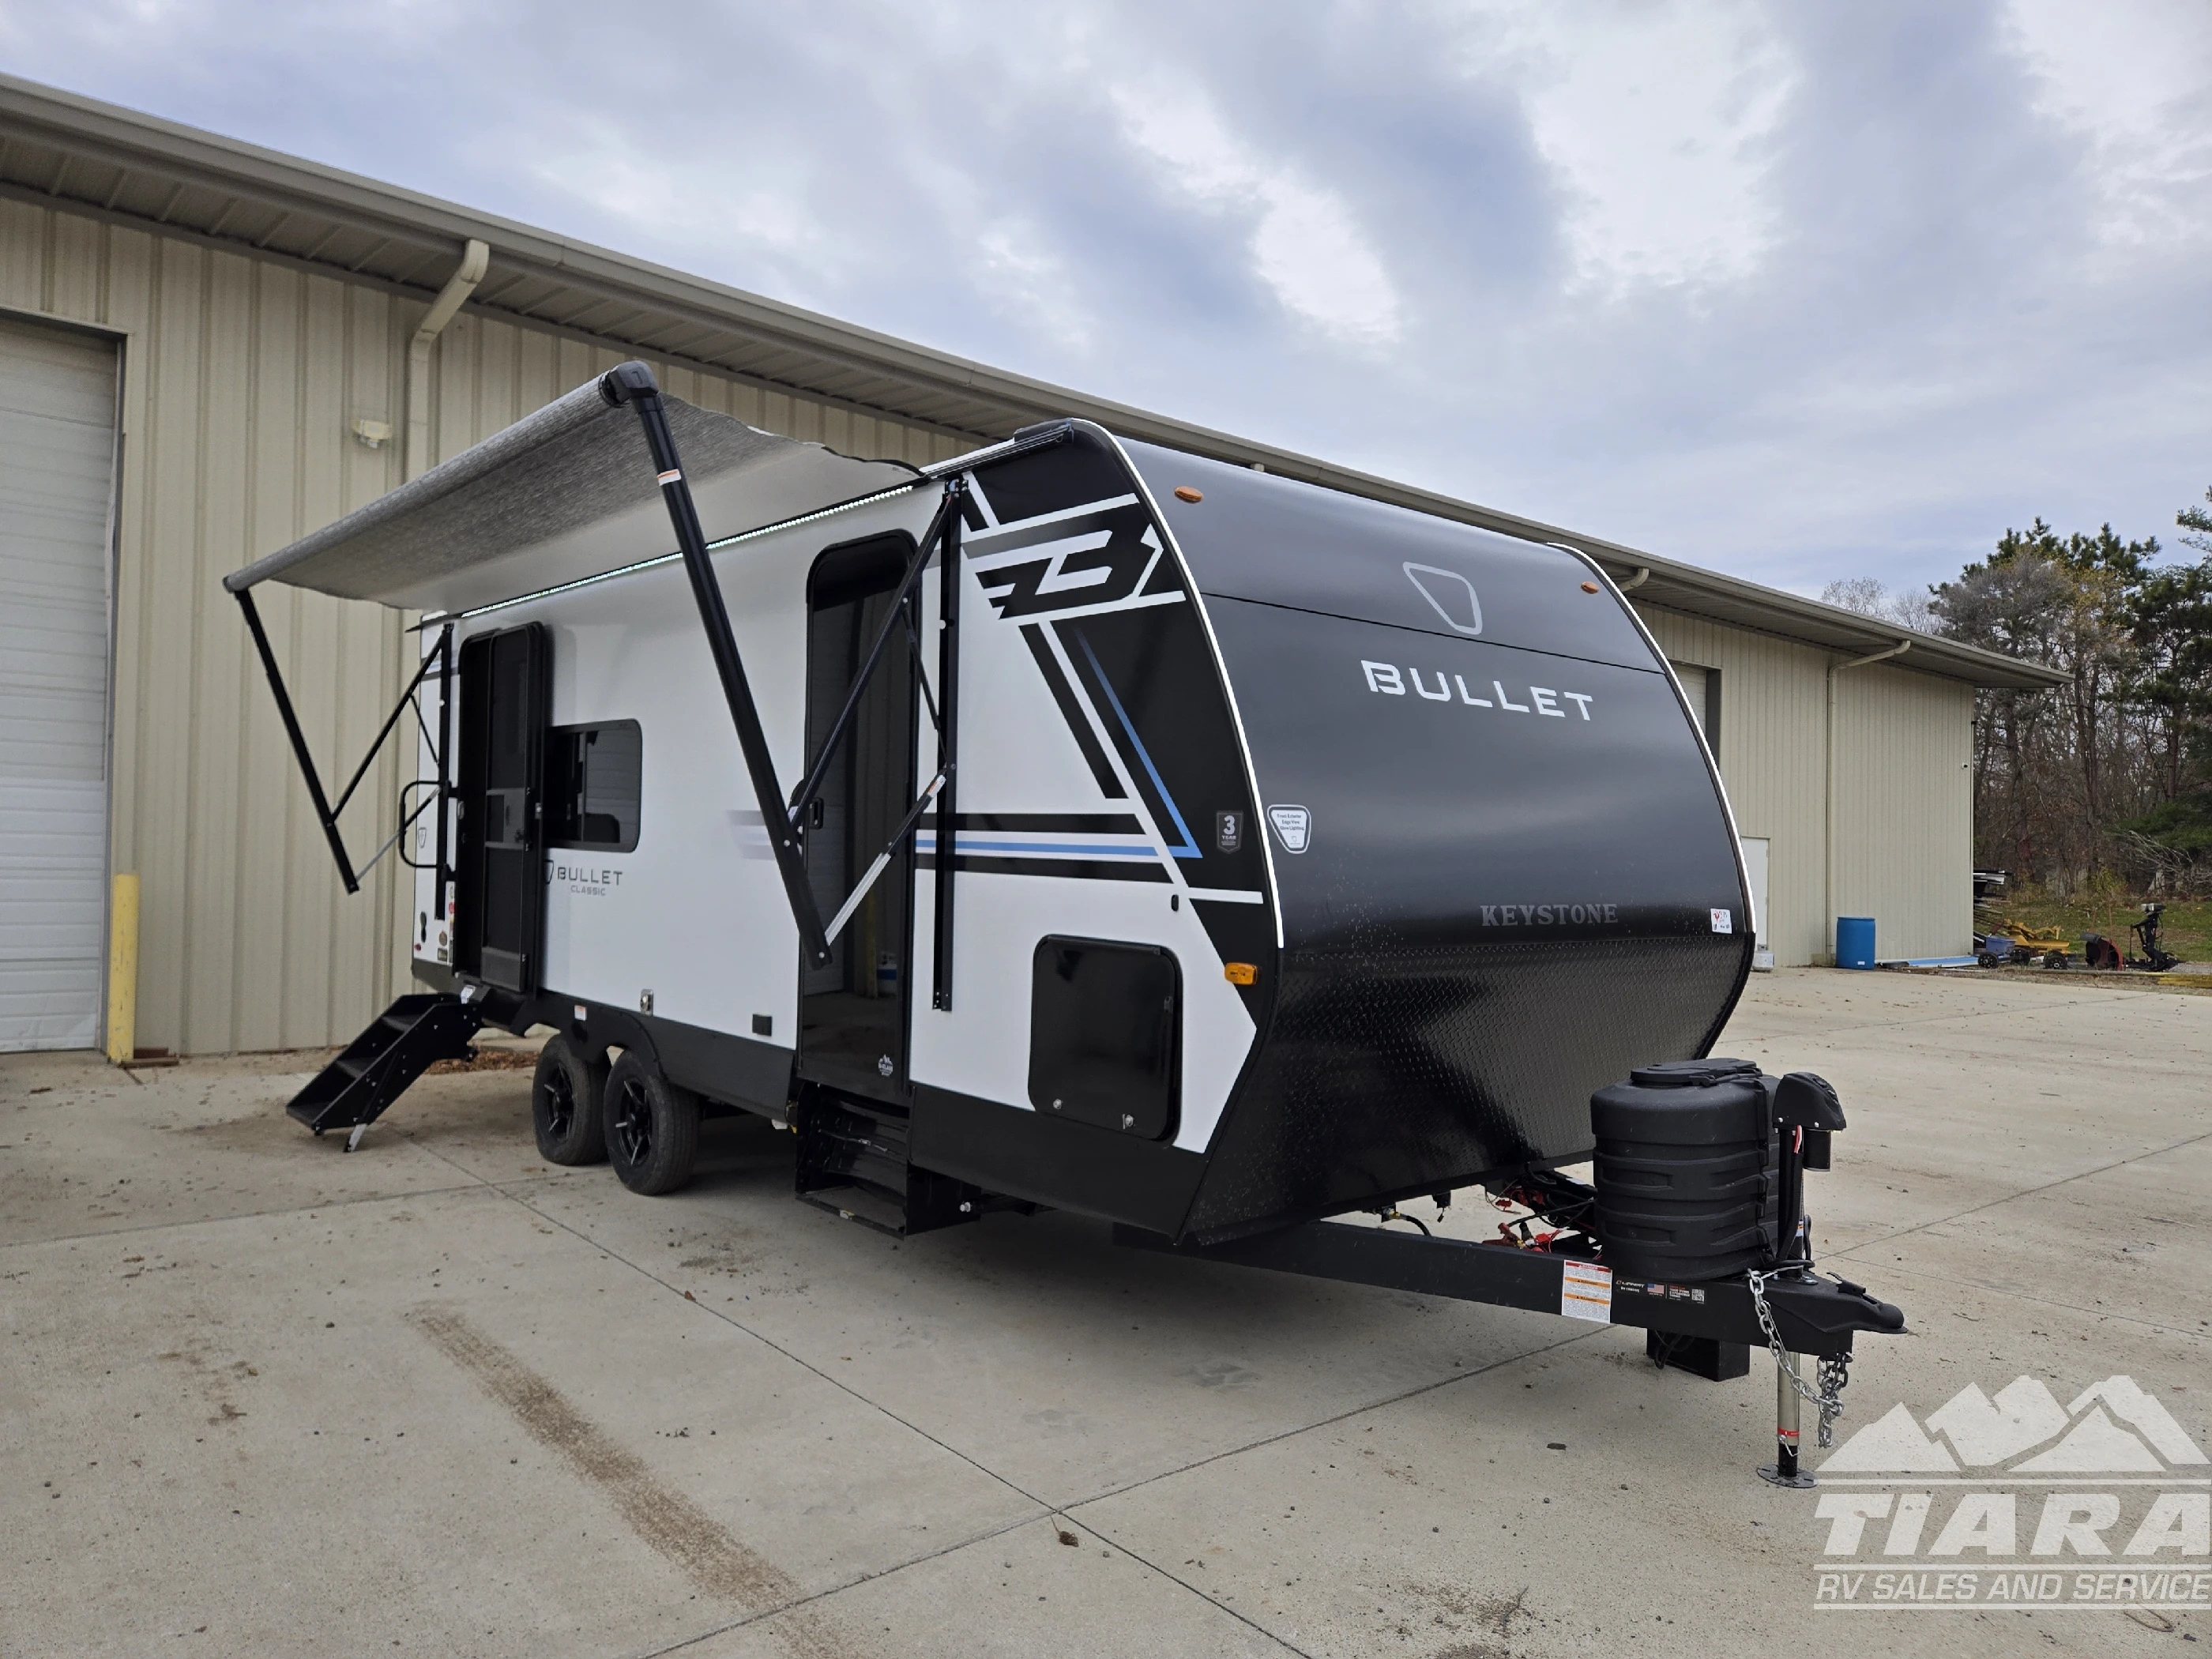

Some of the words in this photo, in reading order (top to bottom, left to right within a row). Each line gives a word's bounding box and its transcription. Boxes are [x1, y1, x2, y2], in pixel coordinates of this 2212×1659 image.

[1360, 660, 1593, 721] BULLET
[1224, 815, 1235, 835] 3
[557, 867, 623, 886] BULLET
[570, 885, 606, 897] CLASSIC
[1480, 903, 1619, 927] KEYSTONE
